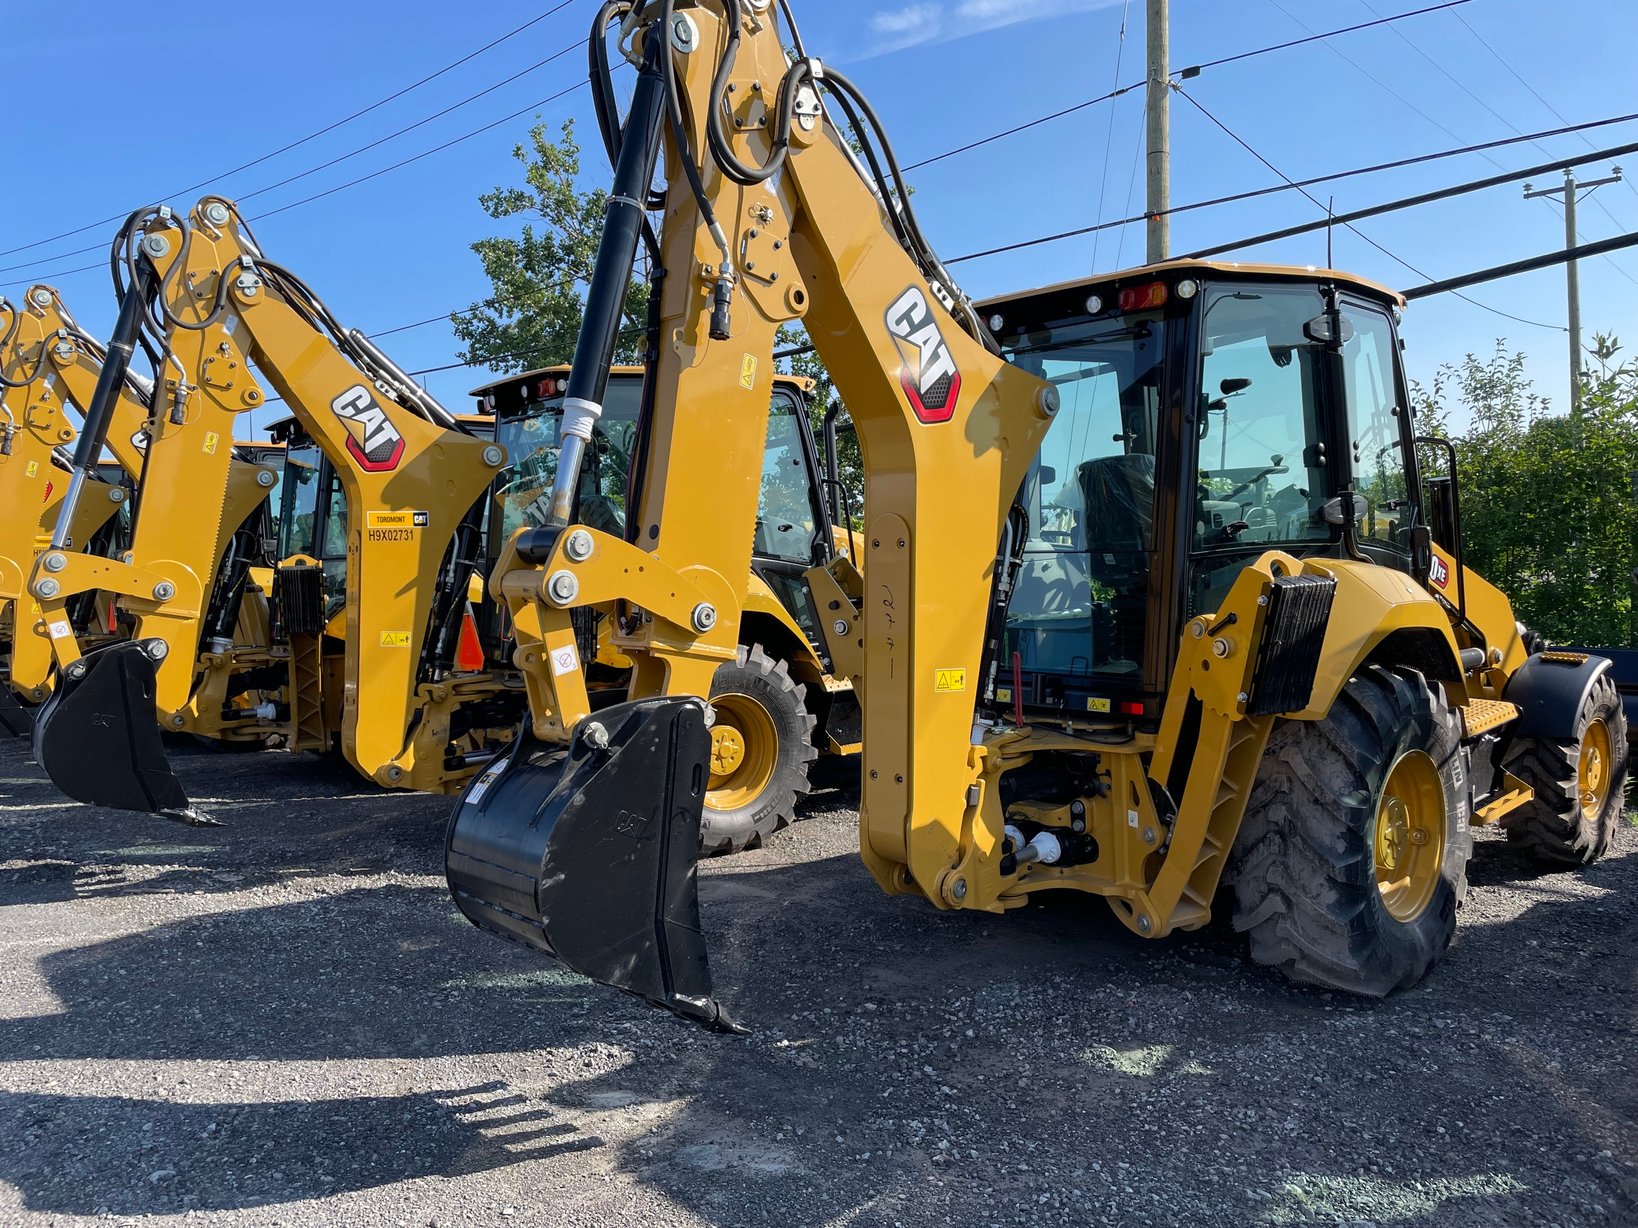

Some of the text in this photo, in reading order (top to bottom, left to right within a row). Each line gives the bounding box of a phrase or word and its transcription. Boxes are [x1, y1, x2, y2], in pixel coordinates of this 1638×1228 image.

[886, 286, 957, 395] CAT
[332, 385, 401, 455] CAT
[368, 530, 414, 541] H9X02731
[413, 514, 427, 524] CAT
